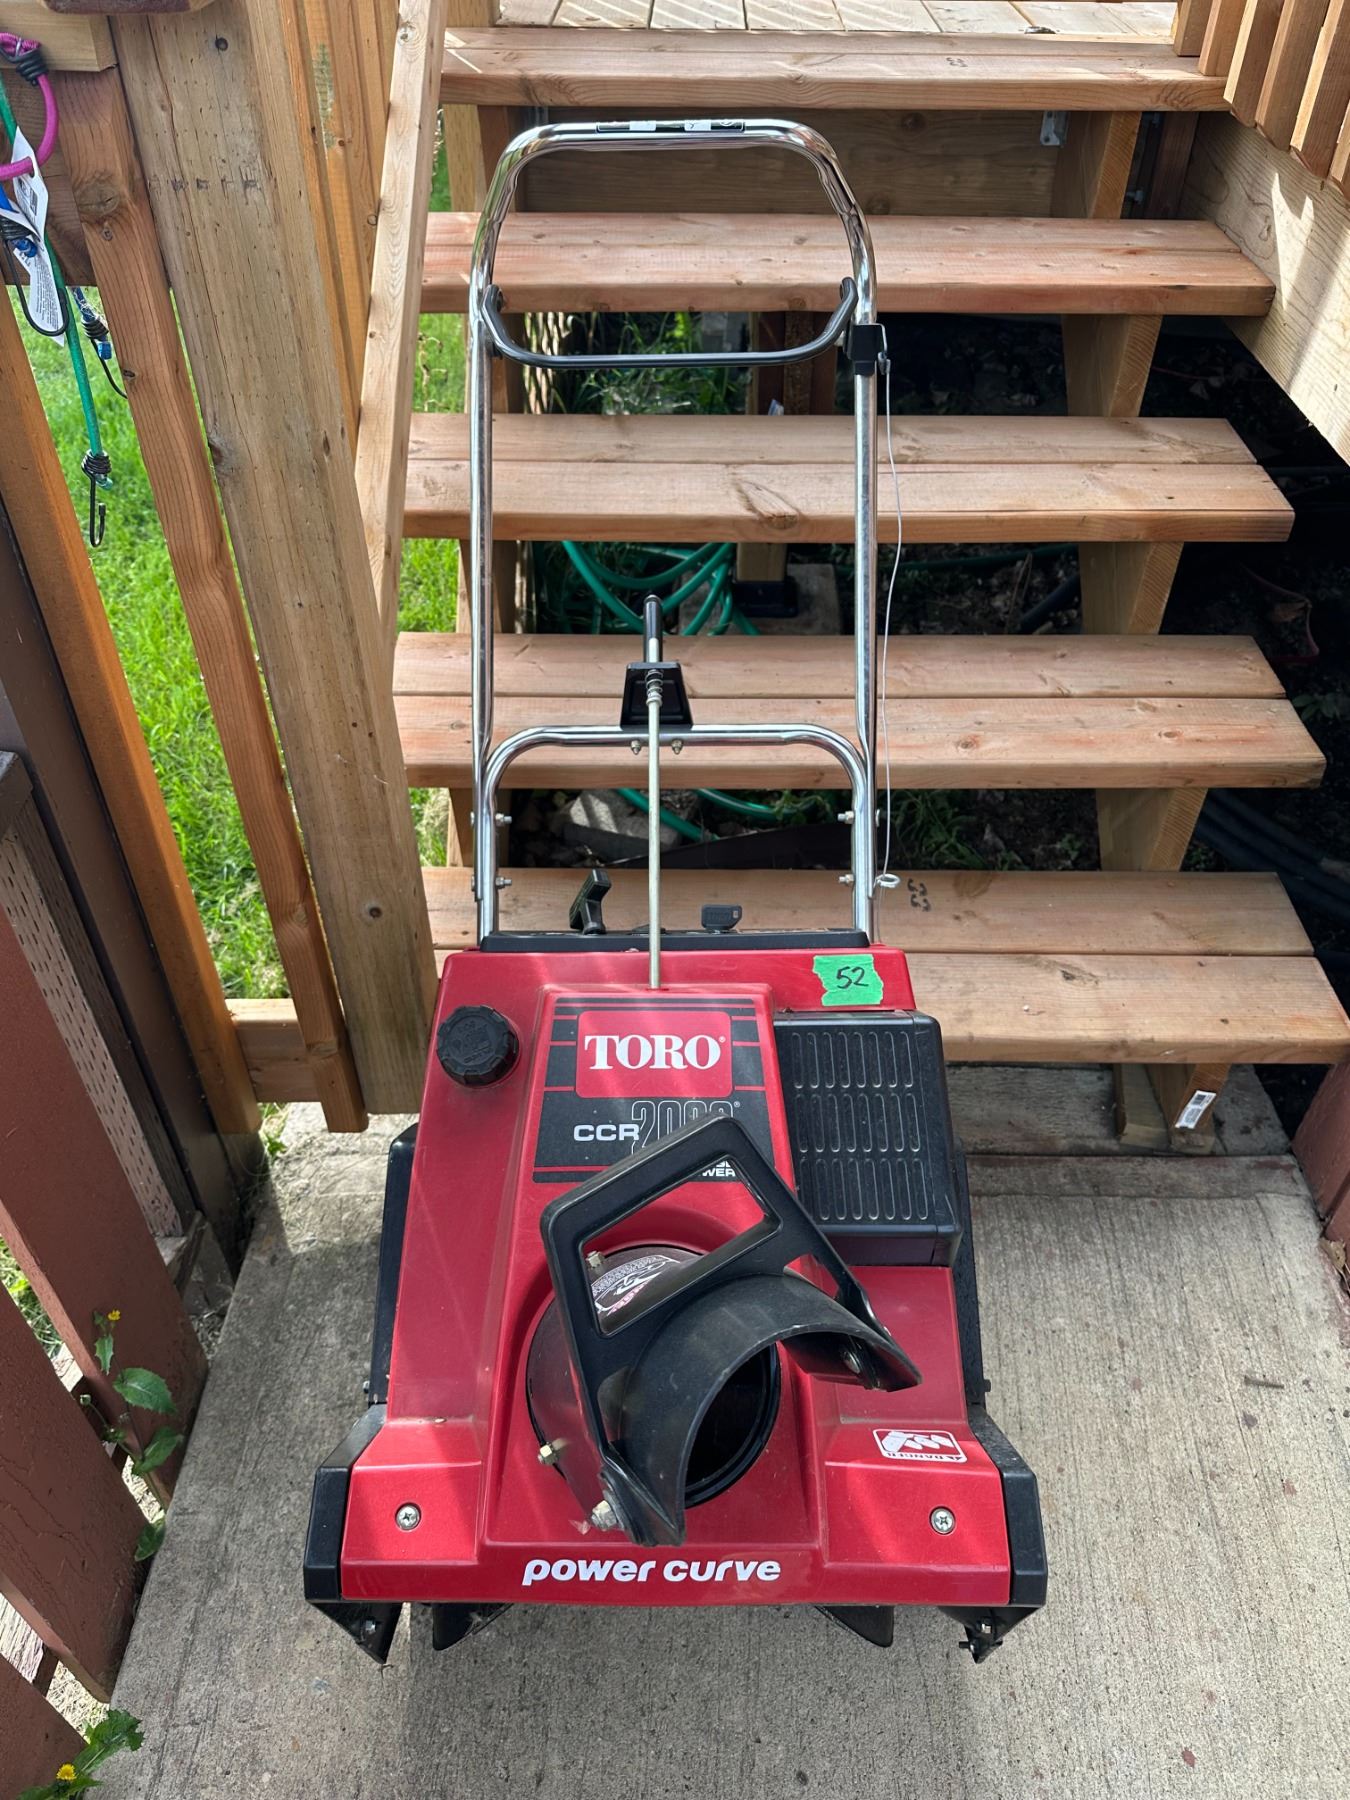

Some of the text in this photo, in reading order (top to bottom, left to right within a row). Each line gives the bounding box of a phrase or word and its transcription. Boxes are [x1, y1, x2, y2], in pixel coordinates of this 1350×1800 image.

[836, 966, 869, 989] 52
[584, 1034, 721, 1070] TORO
[573, 1100, 734, 1155] CCR 20
[522, 1559, 781, 1586] power curve
